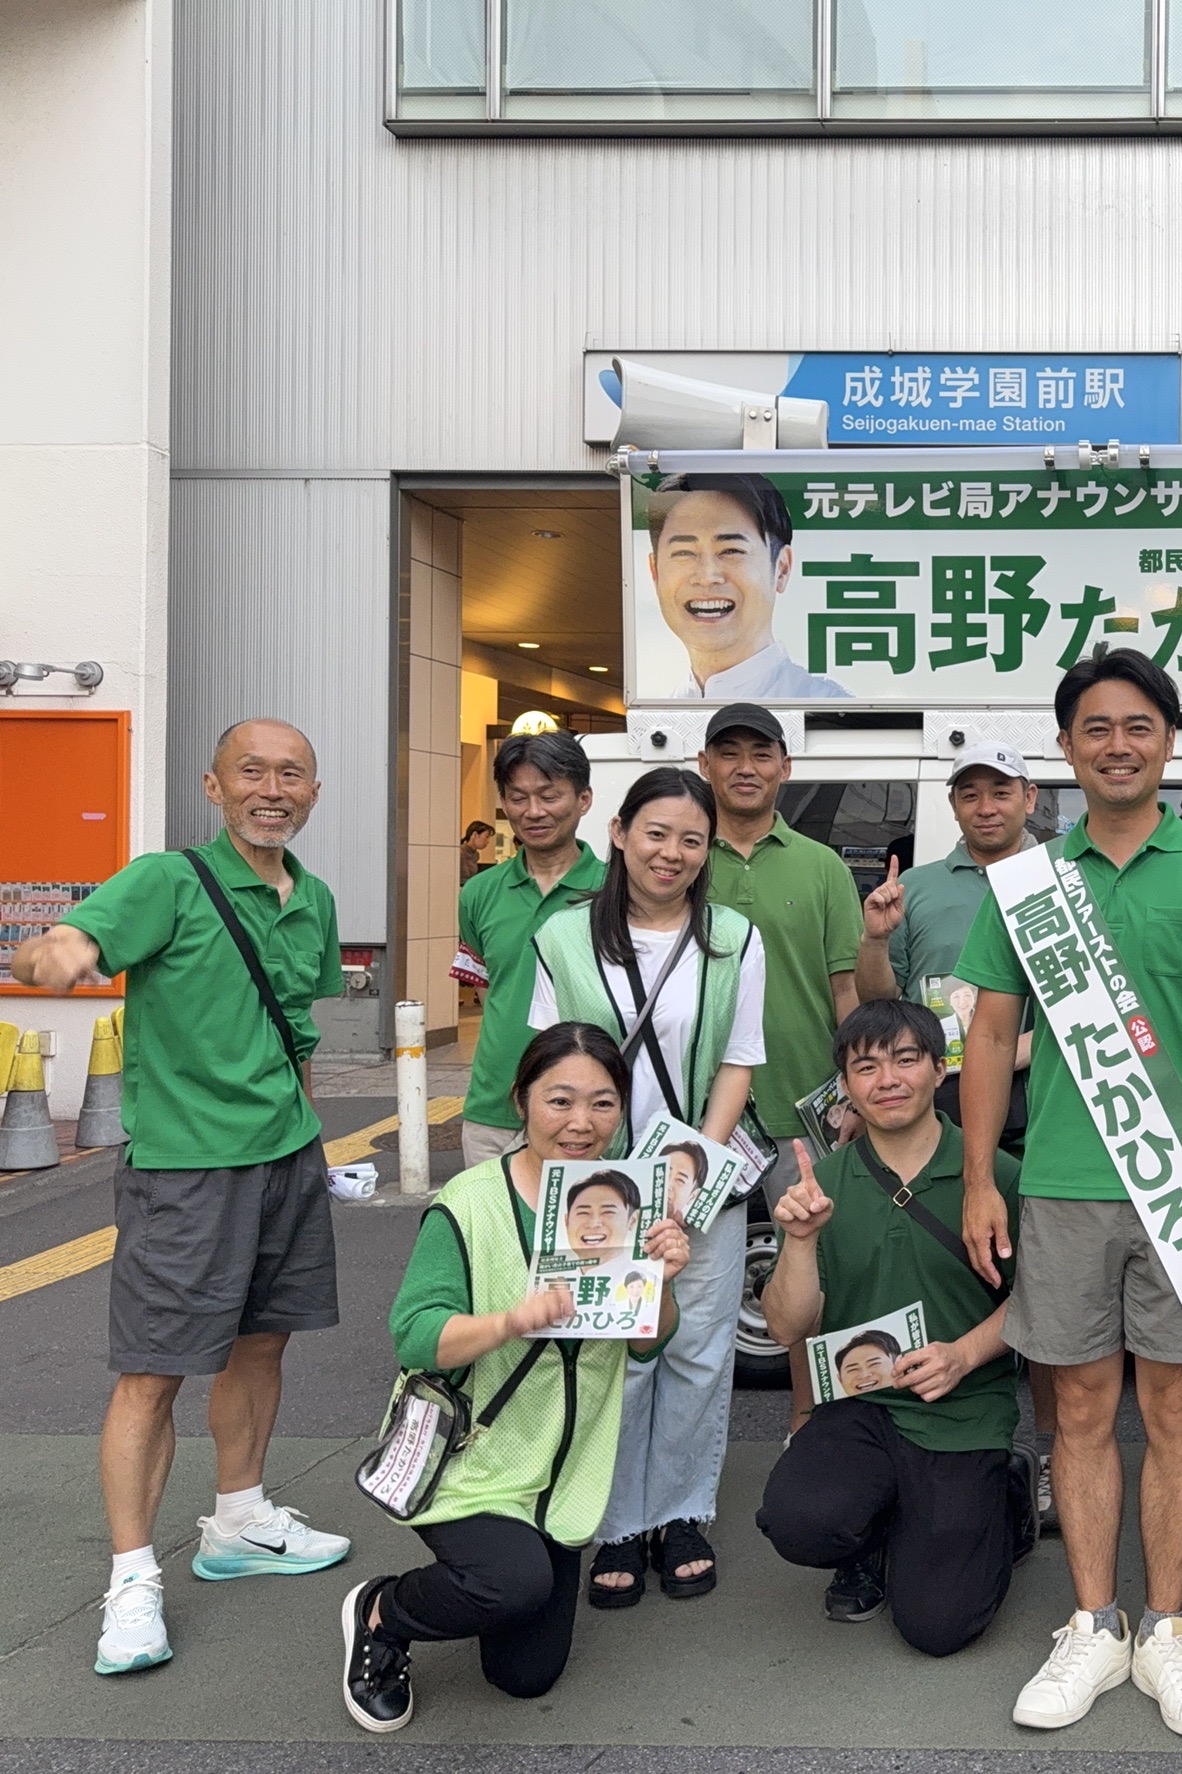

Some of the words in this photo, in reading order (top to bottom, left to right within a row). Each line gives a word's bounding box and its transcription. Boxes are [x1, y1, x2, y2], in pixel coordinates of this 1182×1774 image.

[841, 366, 1126, 409] 成城学園前駅
[842, 414, 997, 434] Seijogakuen-mae
[1002, 414, 1066, 432] Station
[1006, 885, 1092, 1008] 高野
[1054, 857, 1140, 1014] 都民ファーストの会
[1130, 1019, 1156, 1053] 公認
[815, 1343, 832, 1402] 元TBSアナウンサ
